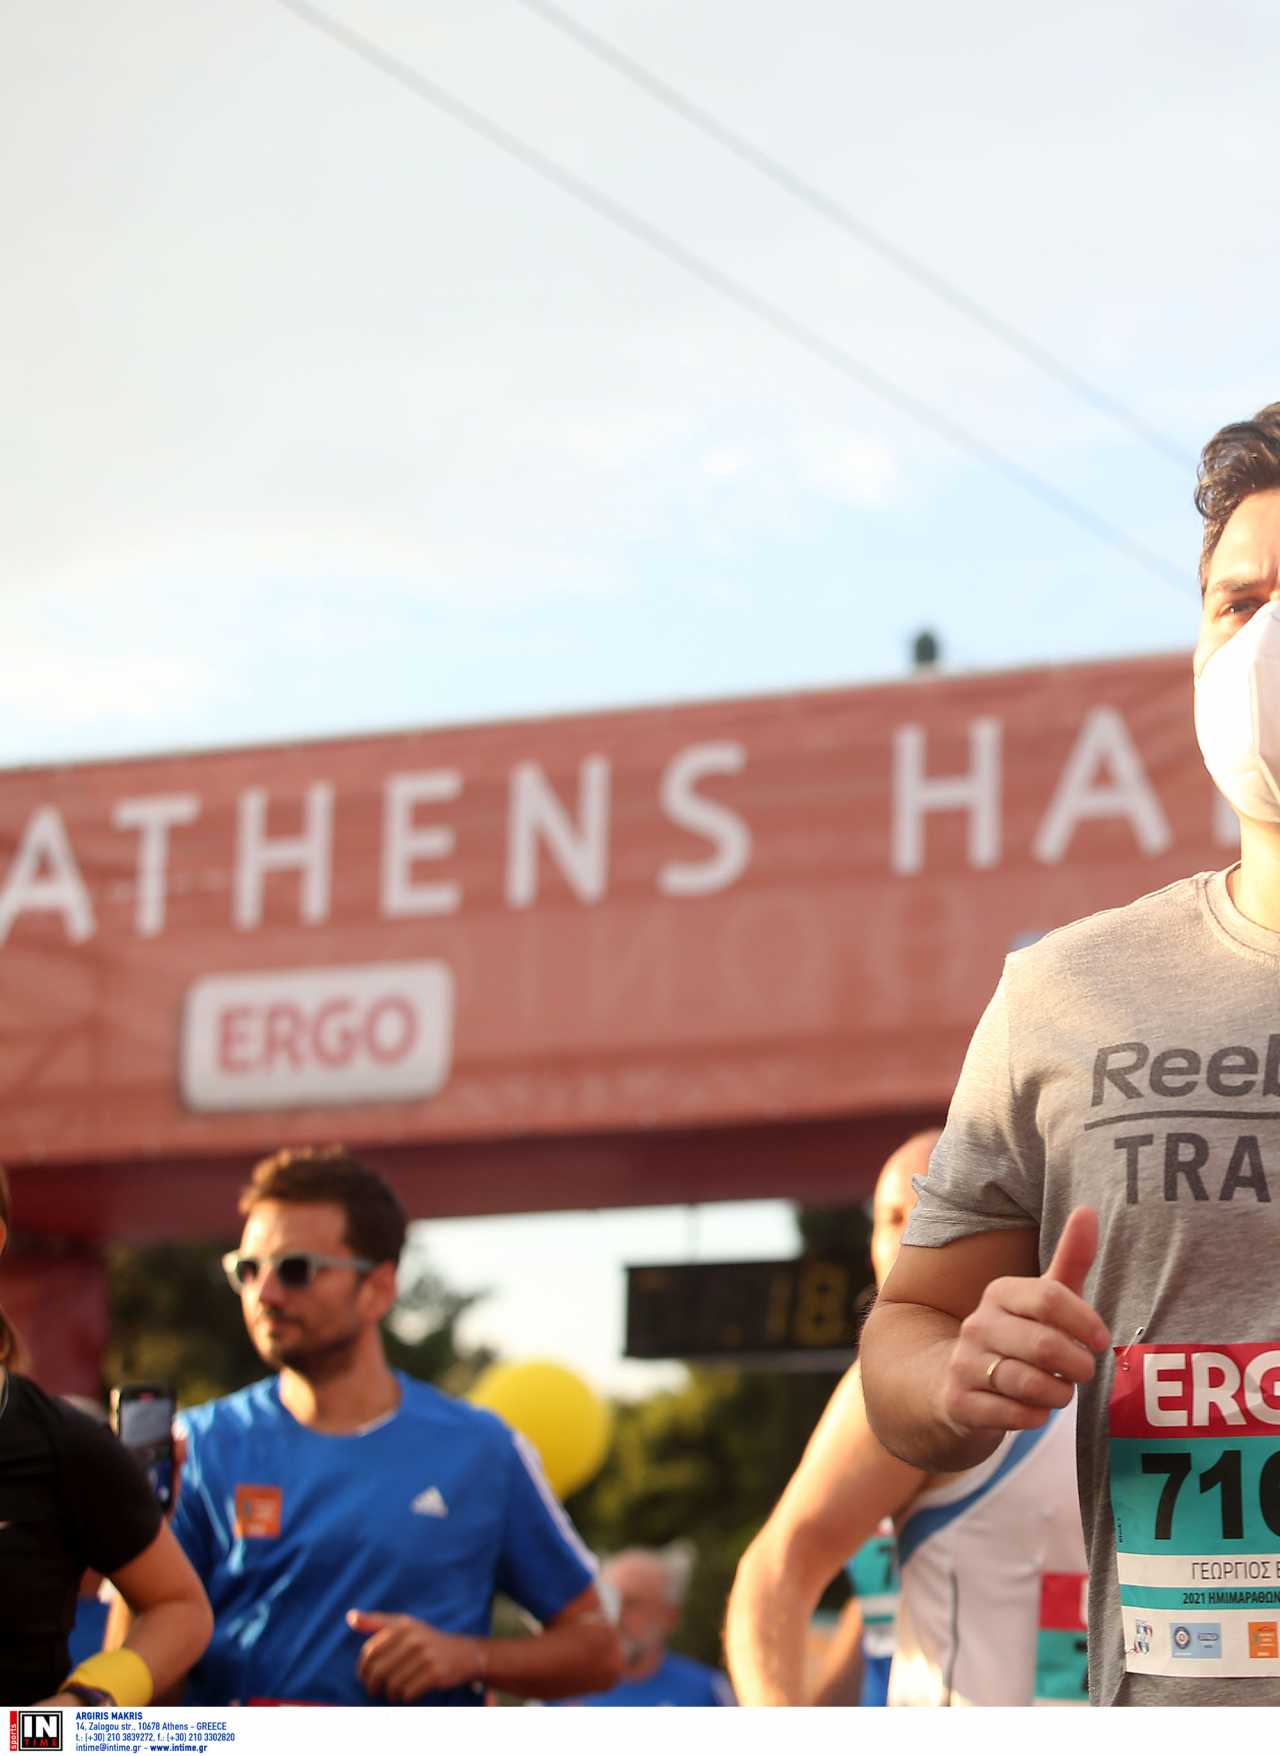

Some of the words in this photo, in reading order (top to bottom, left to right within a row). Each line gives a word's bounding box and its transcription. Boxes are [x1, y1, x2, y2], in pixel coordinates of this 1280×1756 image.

[0, 741, 753, 946] ATHENS
[891, 705, 1241, 876] HA
[218, 995, 418, 1073] ERGO
[1191, 1561, 1272, 1580] ΓΕΩΡΓΙΟΣ
[1183, 1592, 1206, 1605] 2021
